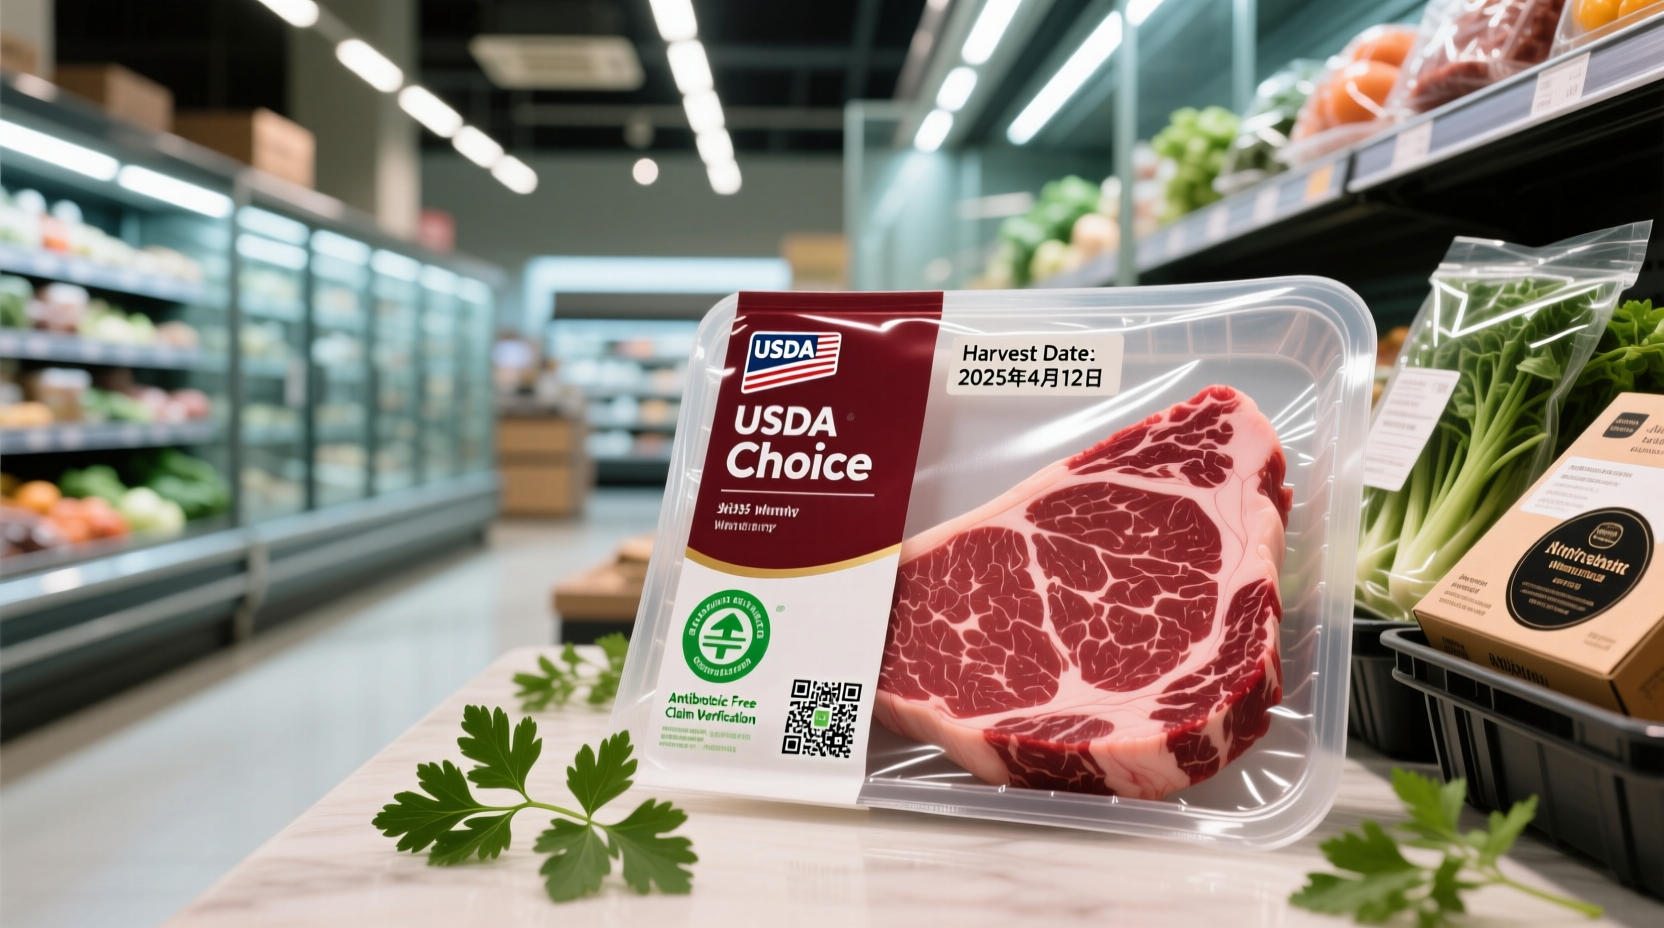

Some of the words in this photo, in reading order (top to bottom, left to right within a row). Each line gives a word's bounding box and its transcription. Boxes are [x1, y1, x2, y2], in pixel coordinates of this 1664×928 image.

[754, 339, 815, 359] USDA
[962, 344, 1037, 362] Harvest
[1043, 344, 1095, 362] Date:
[957, 367, 1102, 388] 2025年4月12日
[734, 405, 837, 437] USDA
[726, 441, 873, 482] Choice
[731, 695, 757, 709] Free
